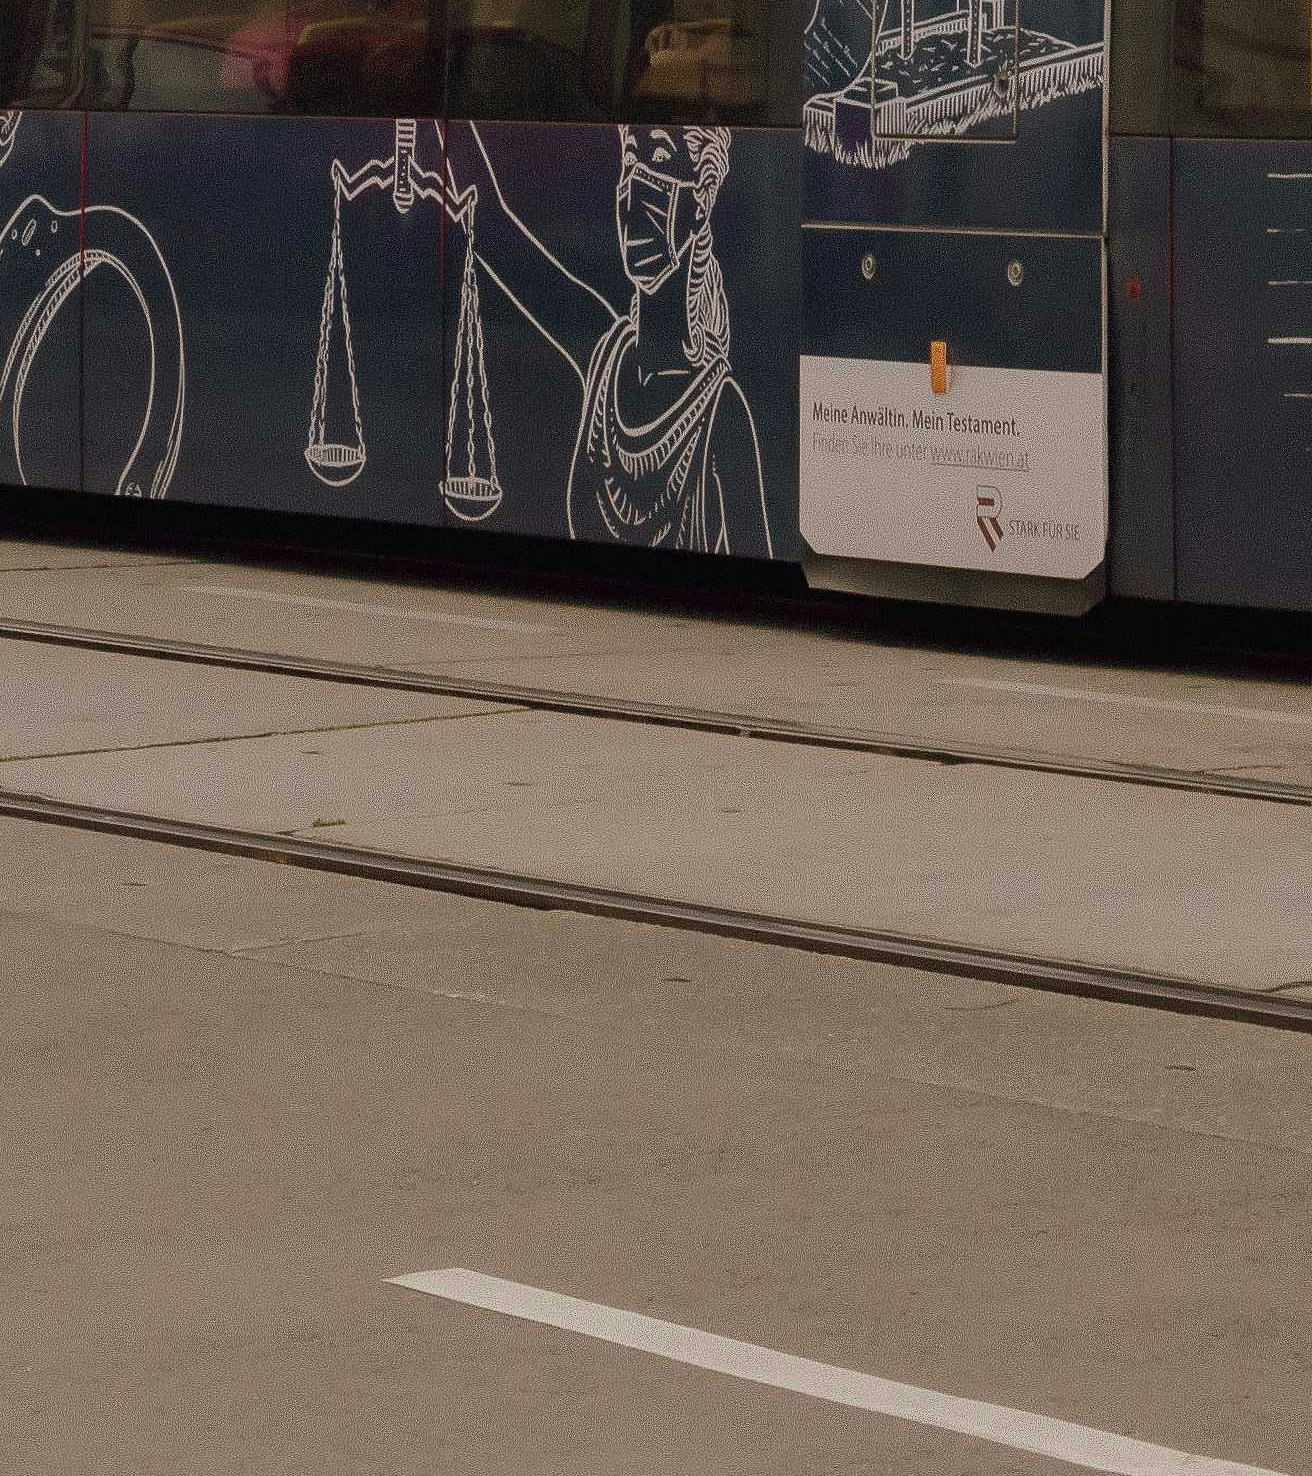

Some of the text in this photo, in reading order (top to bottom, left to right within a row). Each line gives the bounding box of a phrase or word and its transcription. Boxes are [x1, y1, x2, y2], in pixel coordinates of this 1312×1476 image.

[812, 402, 1021, 437] Meine Anwältin. Mein Testament.
[852, 434, 868, 454] Sie
[896, 442, 928, 462] unter
[1008, 520, 1040, 536] STARK
[1065, 523, 1081, 541] SIE
